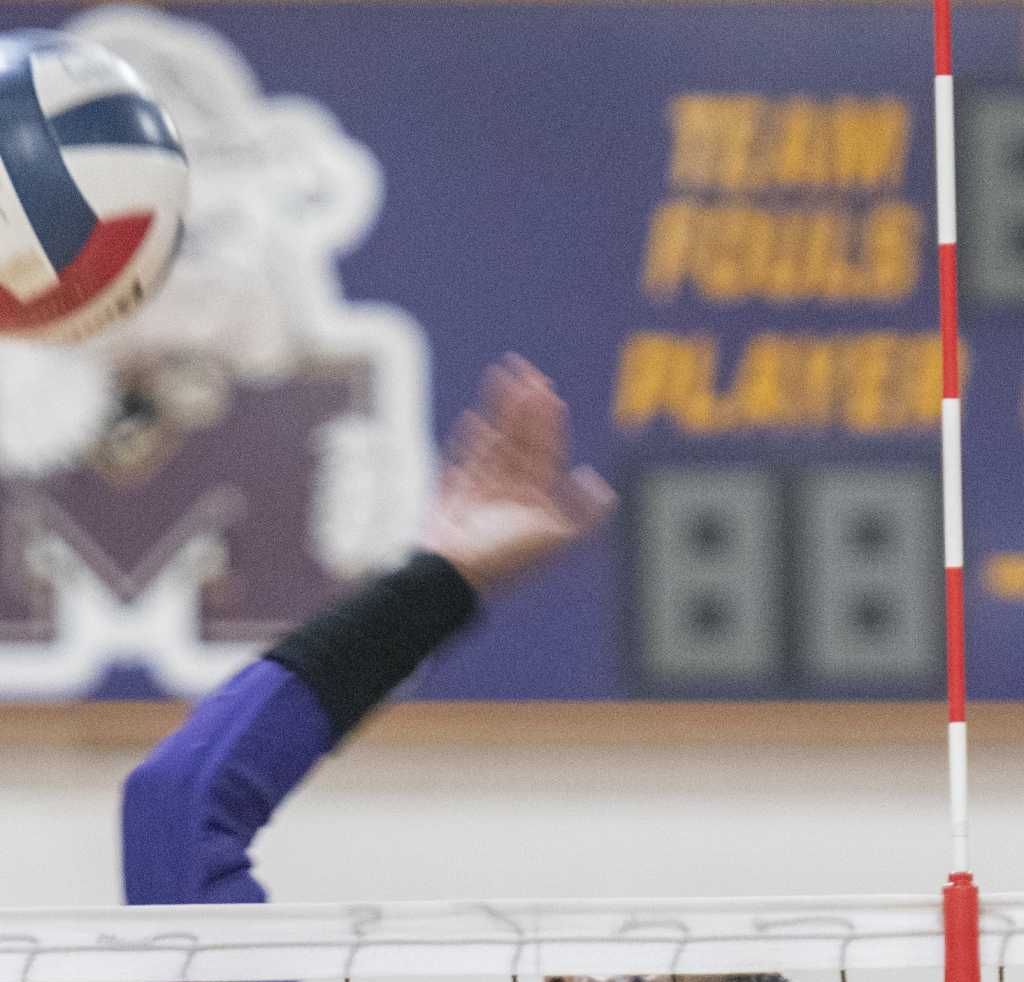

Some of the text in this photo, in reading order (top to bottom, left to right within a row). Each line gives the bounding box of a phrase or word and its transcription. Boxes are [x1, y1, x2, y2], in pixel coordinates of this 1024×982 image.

[669, 94, 912, 189] TEAM
[643, 200, 924, 300] FOULS
[615, 331, 970, 435] PLAYER
